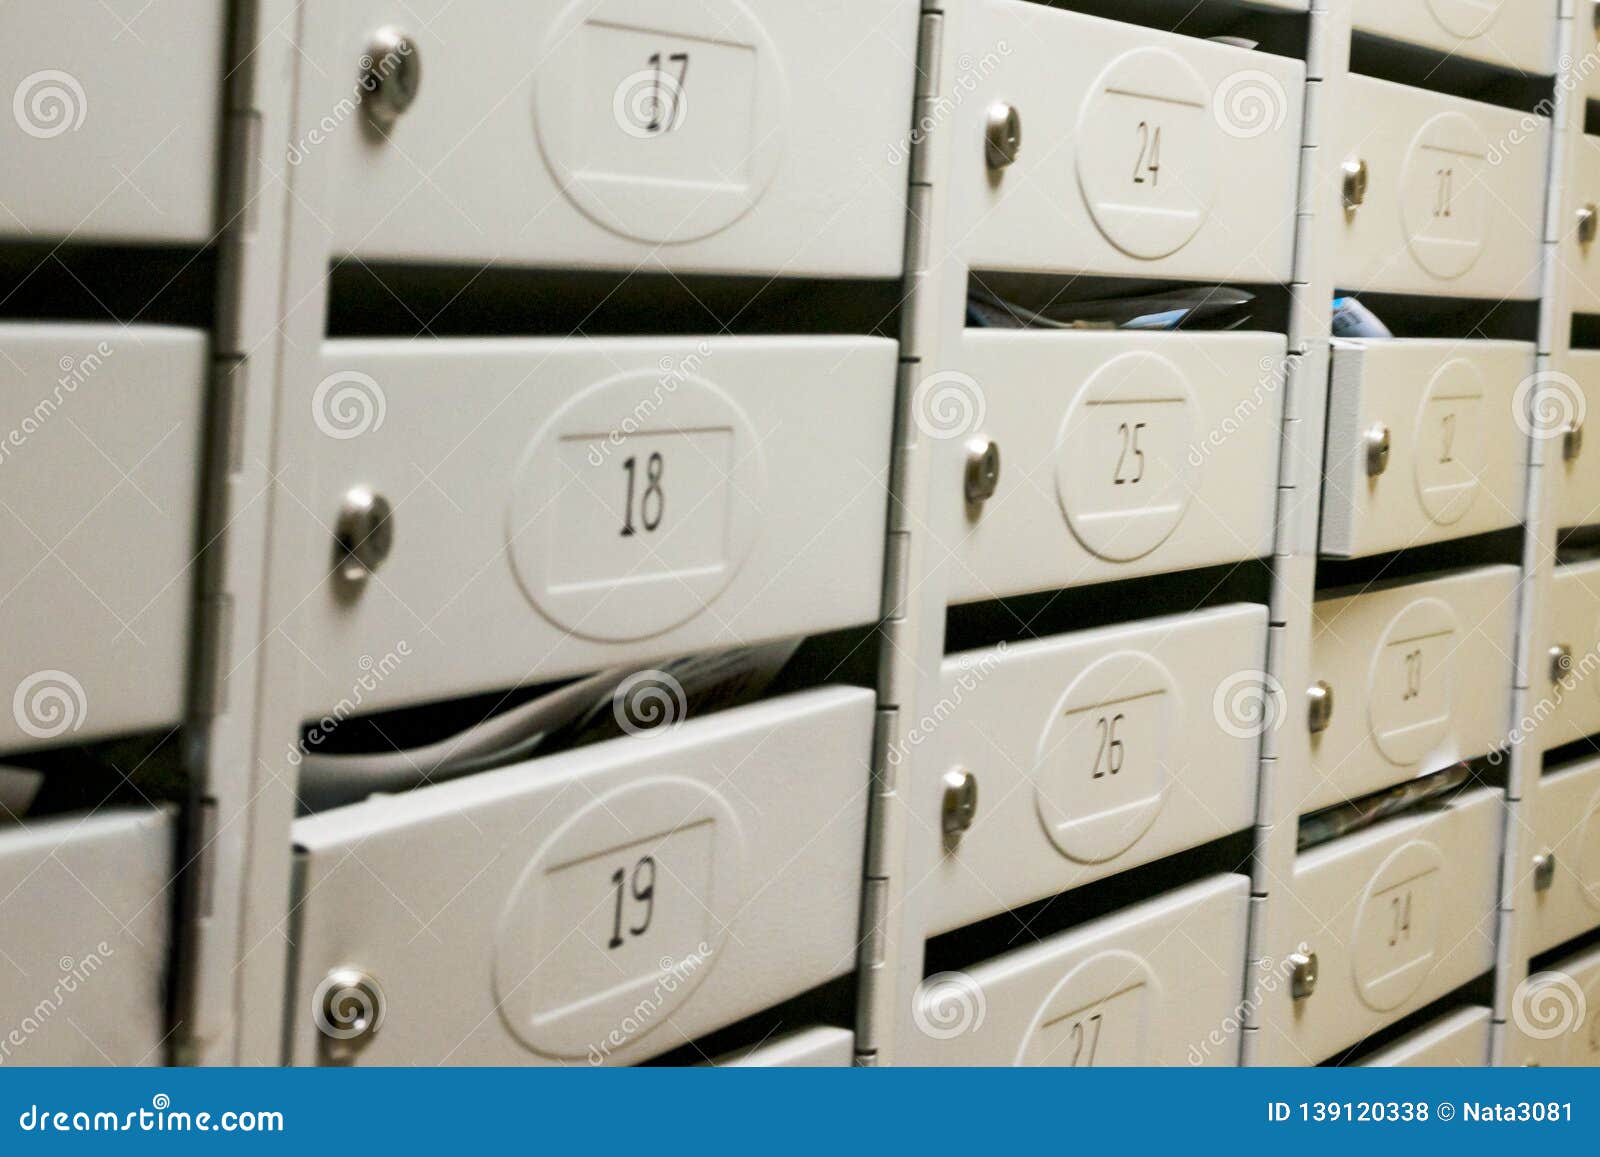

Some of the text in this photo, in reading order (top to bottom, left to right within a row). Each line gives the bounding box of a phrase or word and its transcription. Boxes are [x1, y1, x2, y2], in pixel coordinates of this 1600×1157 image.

[647, 52, 688, 132] 17
[1132, 120, 1161, 186] 24
[1113, 421, 1147, 485] 25
[619, 451, 664, 537] 18
[1092, 713, 1125, 779] 26
[607, 855, 656, 950] 19
